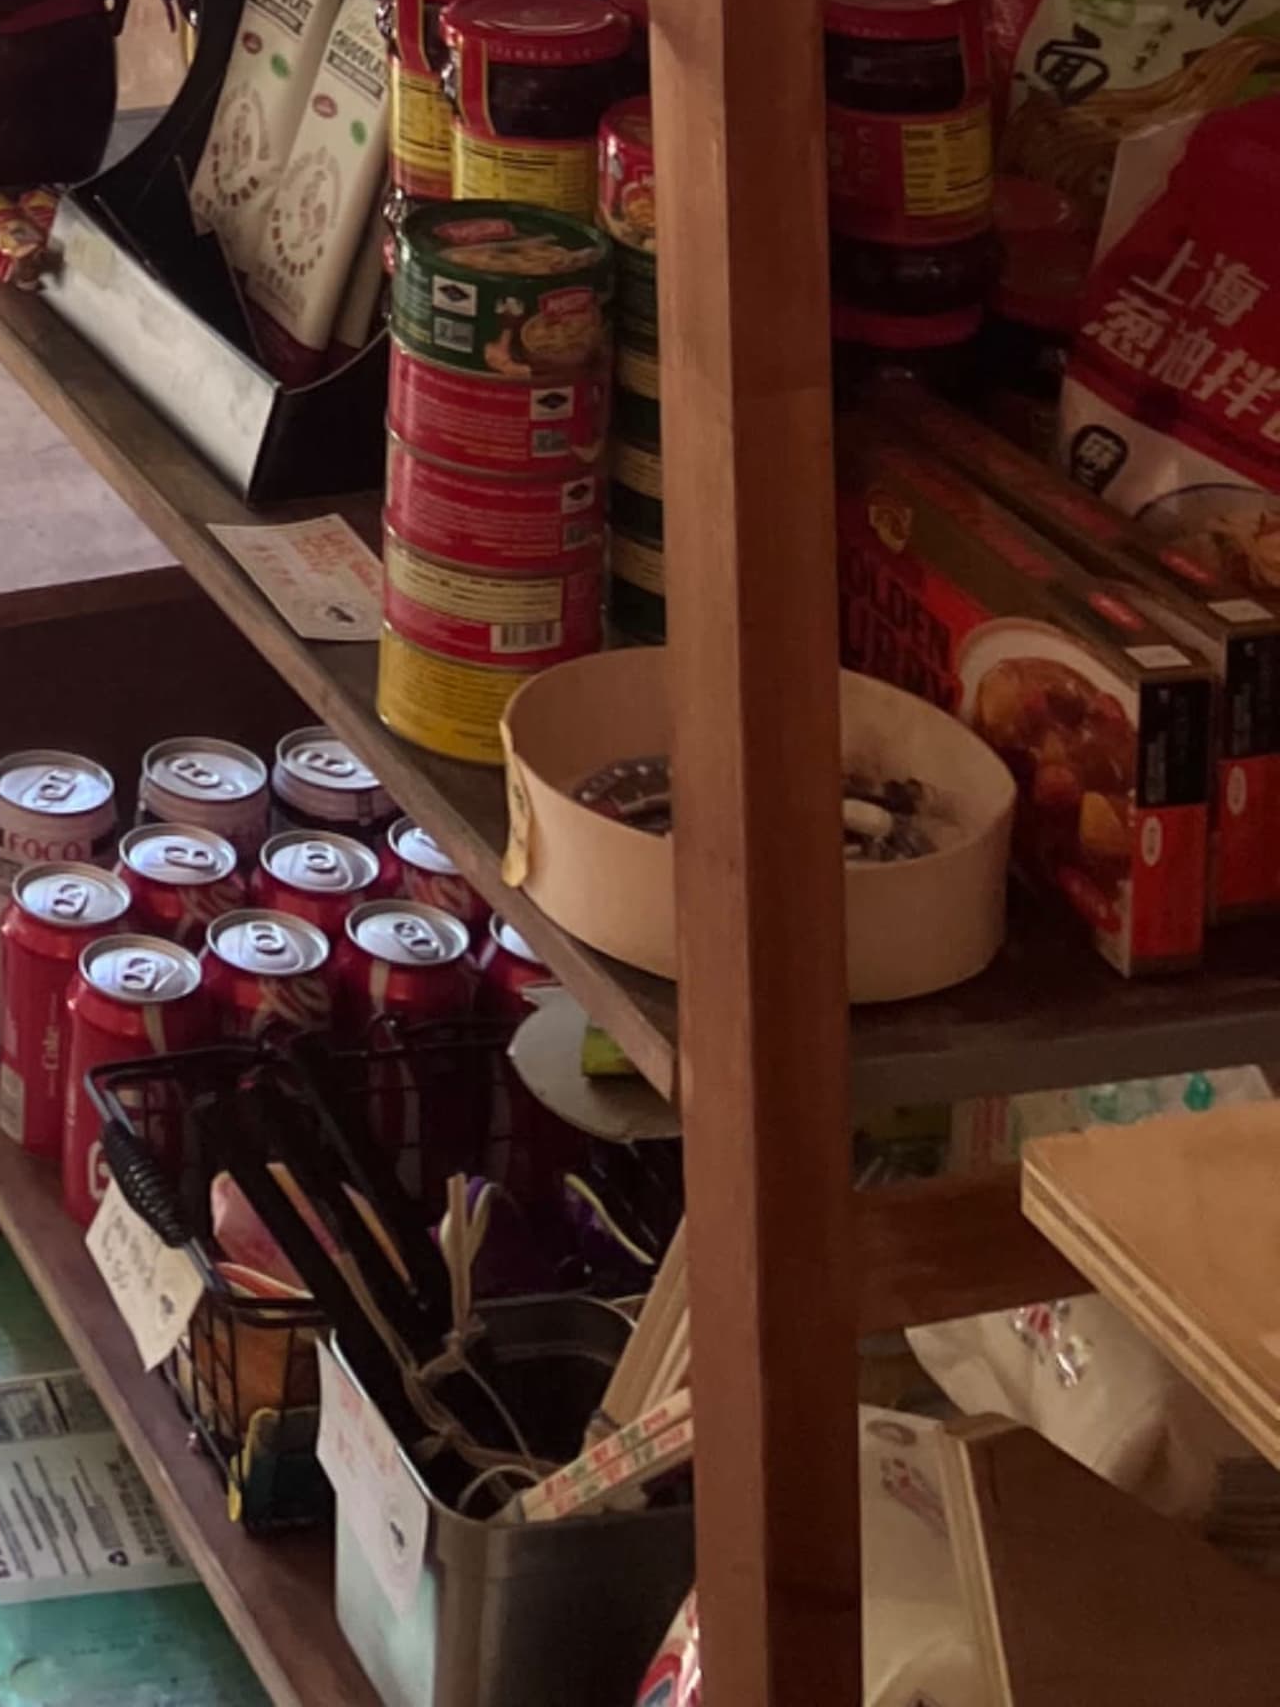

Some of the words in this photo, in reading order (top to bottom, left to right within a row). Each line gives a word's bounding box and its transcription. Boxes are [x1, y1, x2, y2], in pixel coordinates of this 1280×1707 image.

[331, 29, 390, 83] CHOCOLAT
[1130, 239, 1270, 328] 上海
[8, 832, 82, 861] FOCO
